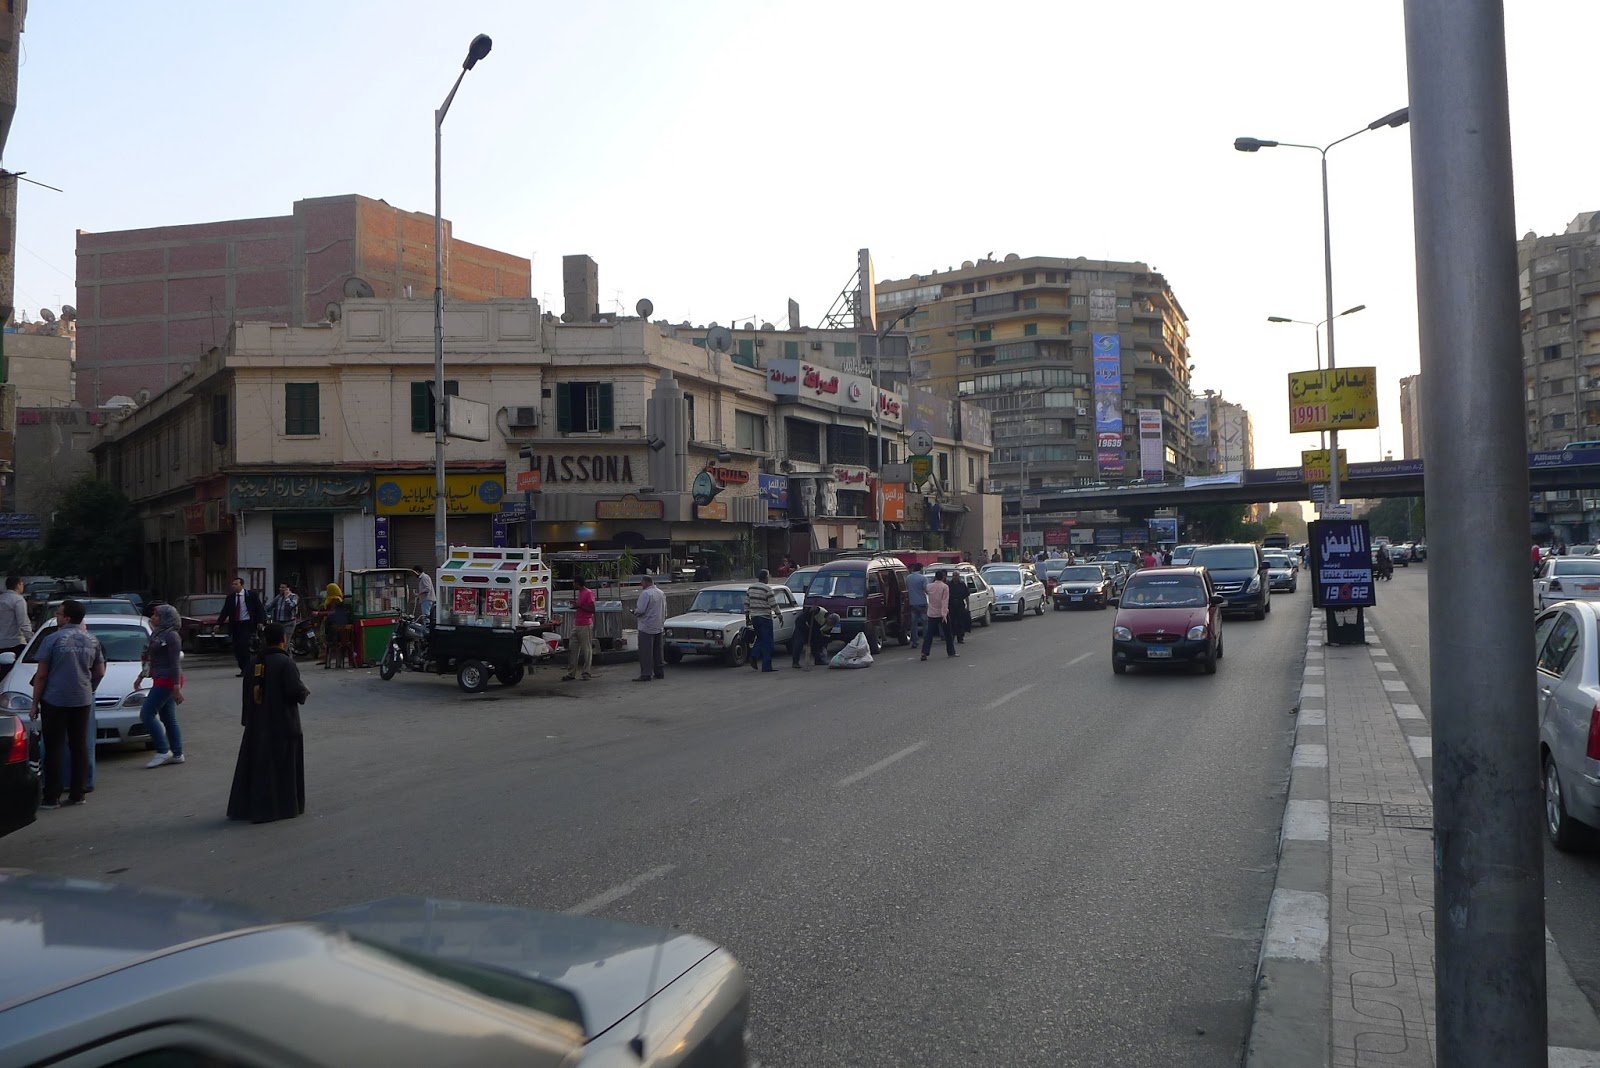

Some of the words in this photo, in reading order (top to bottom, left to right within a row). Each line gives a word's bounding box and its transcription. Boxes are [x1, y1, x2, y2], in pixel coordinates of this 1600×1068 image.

[770, 369, 797, 384] صرافة
[1291, 371, 1328, 399] البرج
[1330, 370, 1367, 393] معامل
[1292, 404, 1327, 425] 19911
[1097, 440, 1122, 448] 19635
[1534, 454, 1562, 462] Allianz
[530, 455, 633, 482] HASSONA
[1305, 468, 1325, 480] 19911
[1321, 524, 1365, 562] الابيض
[1326, 583, 1369, 600] 19682
